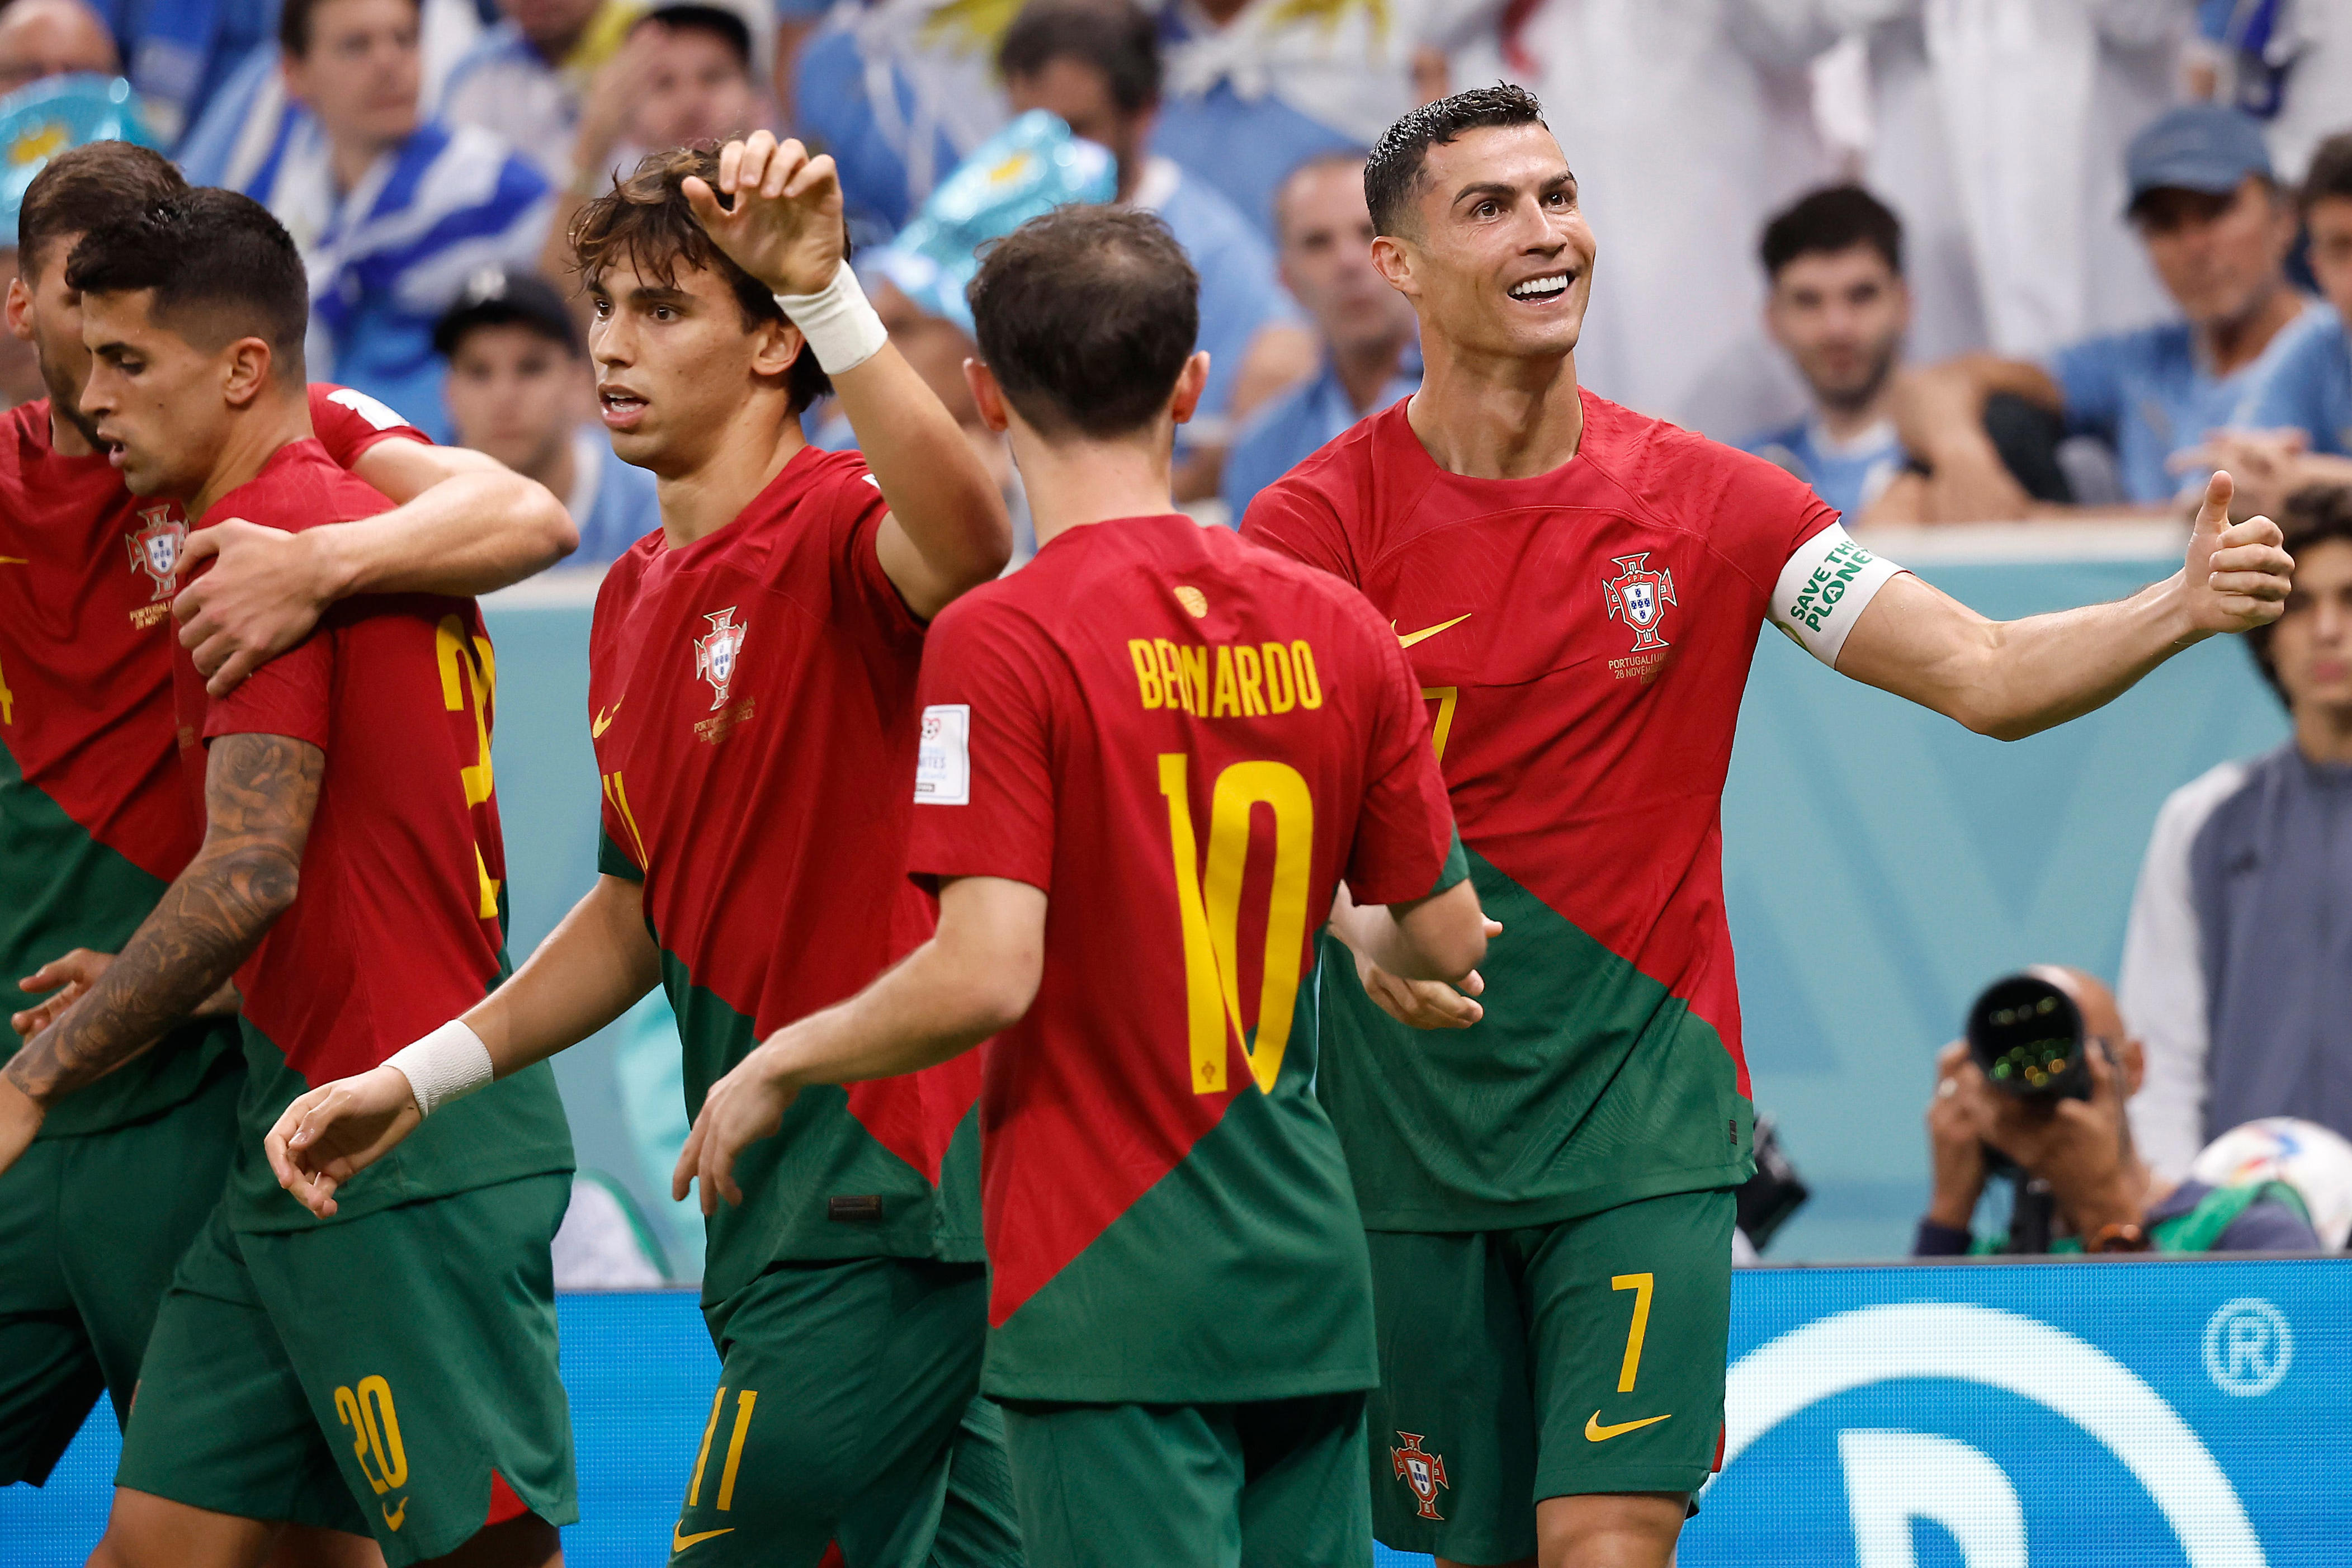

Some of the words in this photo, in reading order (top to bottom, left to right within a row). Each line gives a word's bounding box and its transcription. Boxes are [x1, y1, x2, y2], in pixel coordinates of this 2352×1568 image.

[1790, 566, 1831, 620] SAVE
[1805, 548, 1873, 632] PLANE
[1420, 686, 1458, 763] 7
[1614, 669, 1624, 679] 28
[1158, 753, 1314, 1095] 10
[1611, 1272, 1654, 1392] 7
[334, 1374, 408, 1495] 20
[688, 1386, 758, 1511] 11
